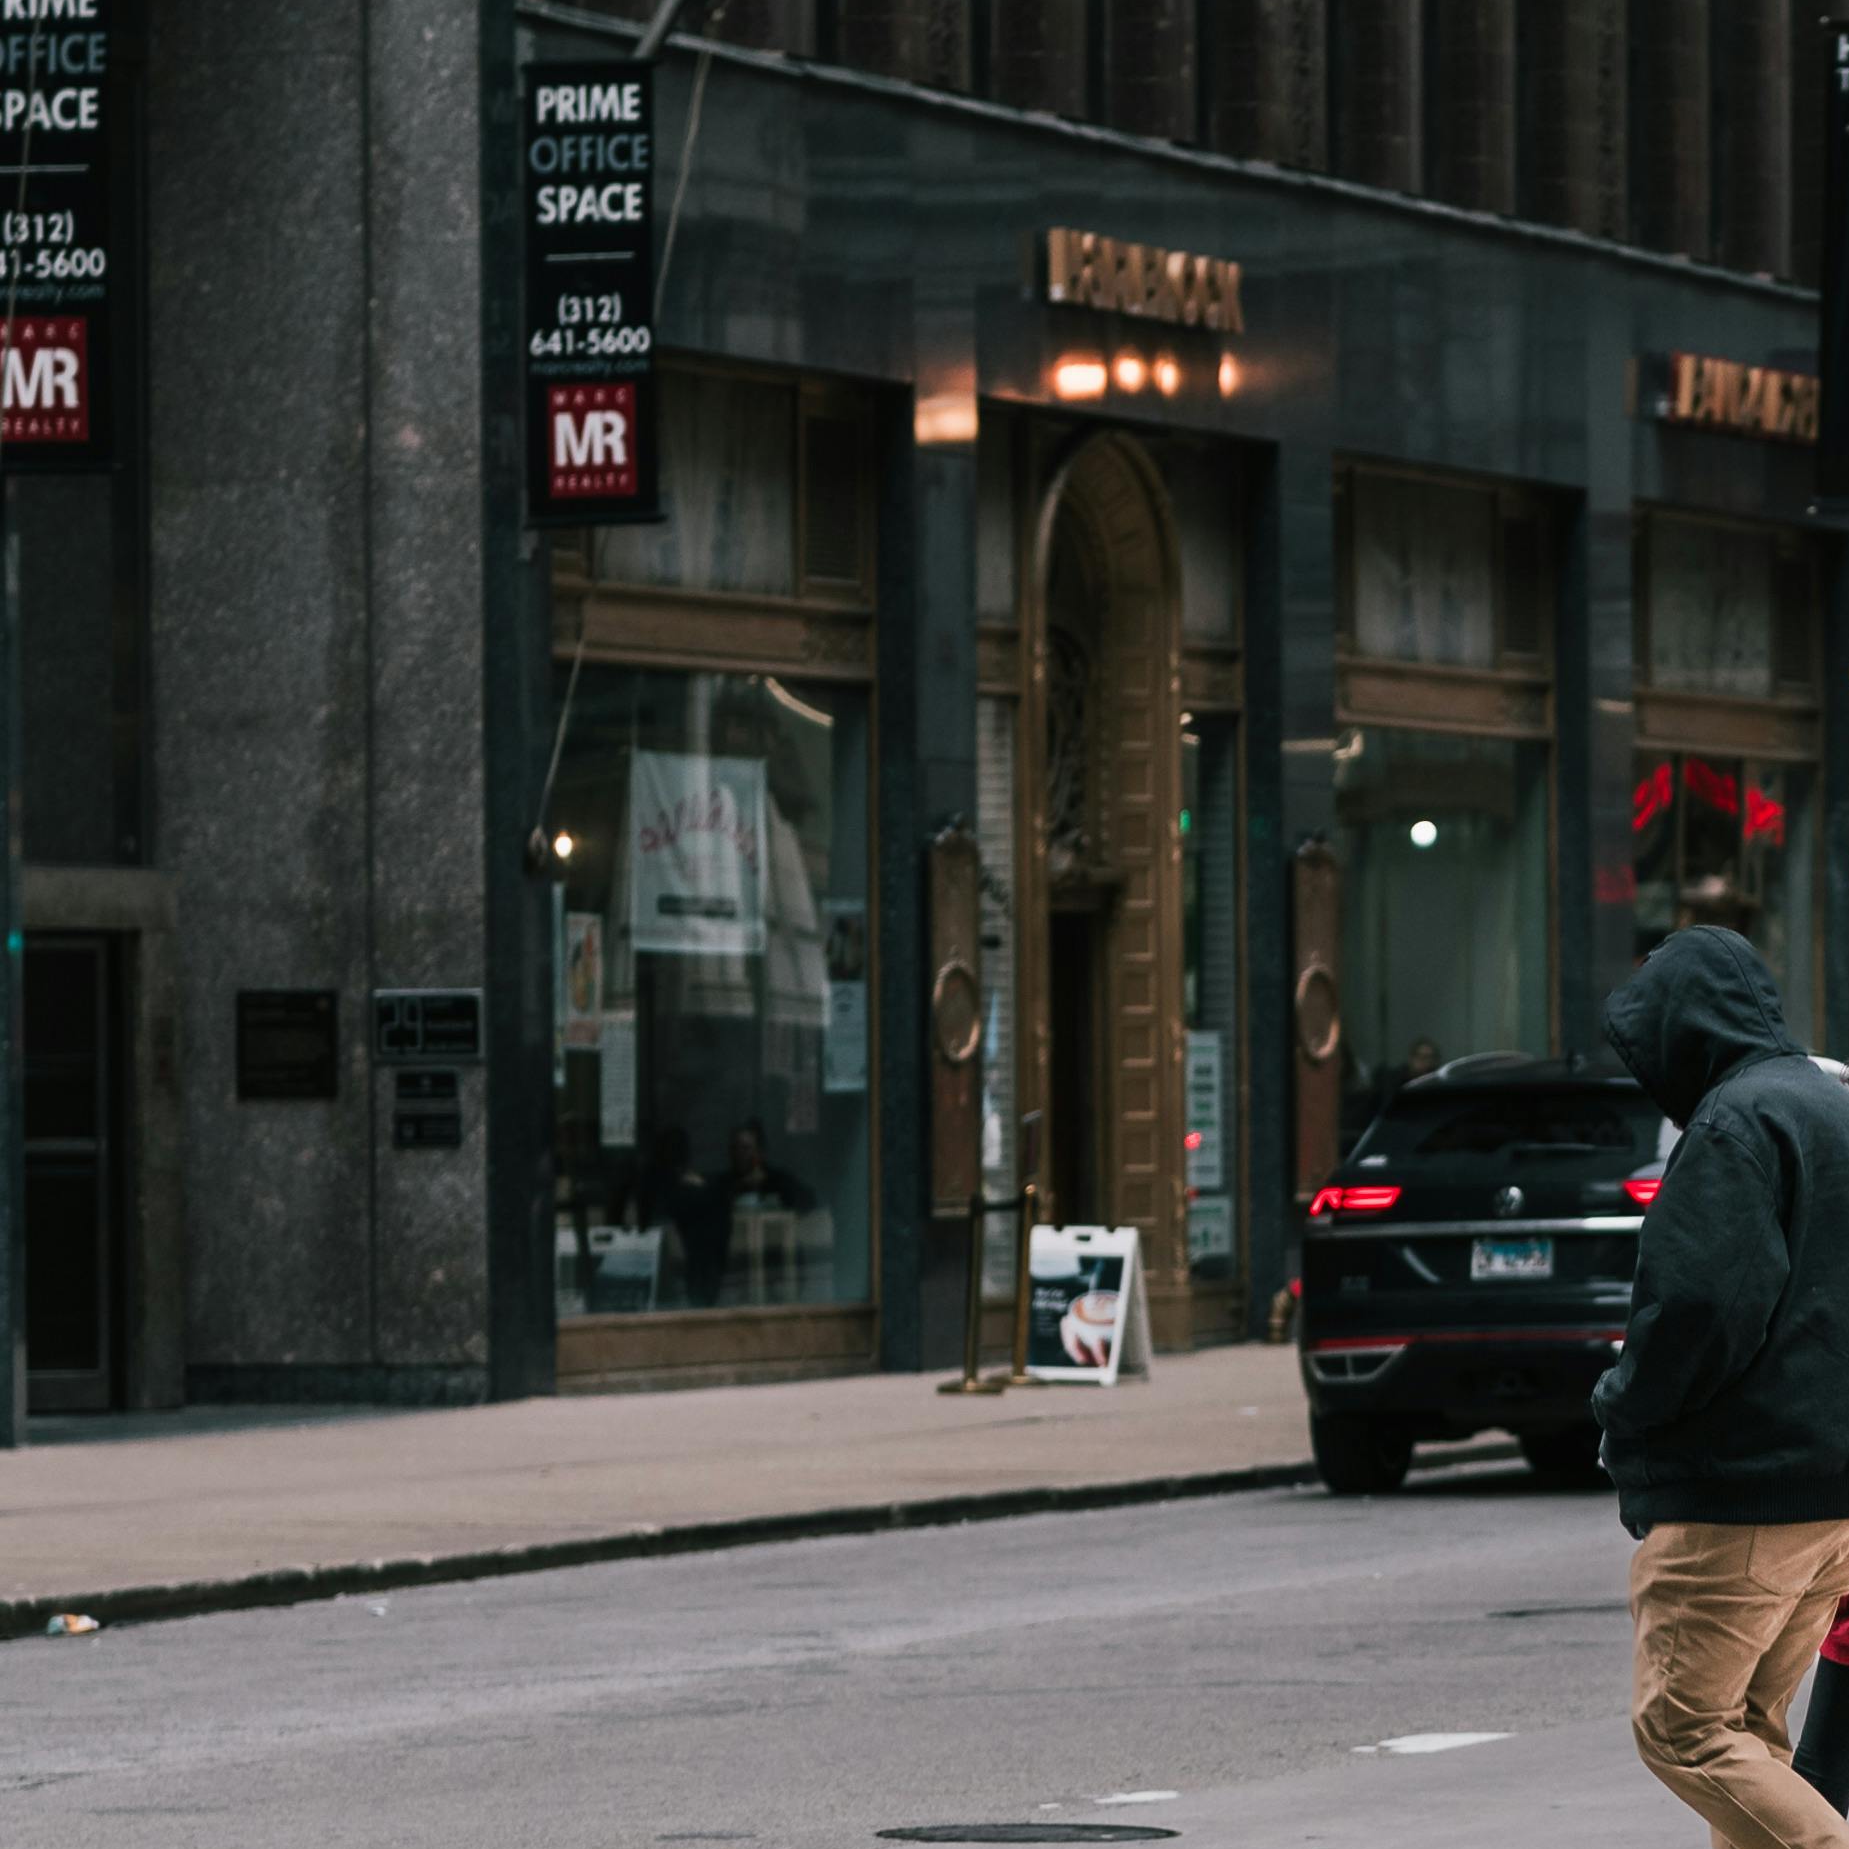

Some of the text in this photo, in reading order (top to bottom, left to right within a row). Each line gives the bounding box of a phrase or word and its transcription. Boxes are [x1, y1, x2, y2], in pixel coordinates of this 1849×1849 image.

[0, 32, 107, 74] FFICE
[0, 87, 98, 132] PACE
[536, 83, 641, 125] PRIME
[529, 133, 649, 174] OFFICE
[536, 182, 643, 224] SPACE
[3, 208, 74, 245] (312)
[557, 291, 622, 325] (312)
[529, 325, 651, 357] 641-5600
[0, 347, 80, 410] MR
[553, 409, 627, 467] MR
